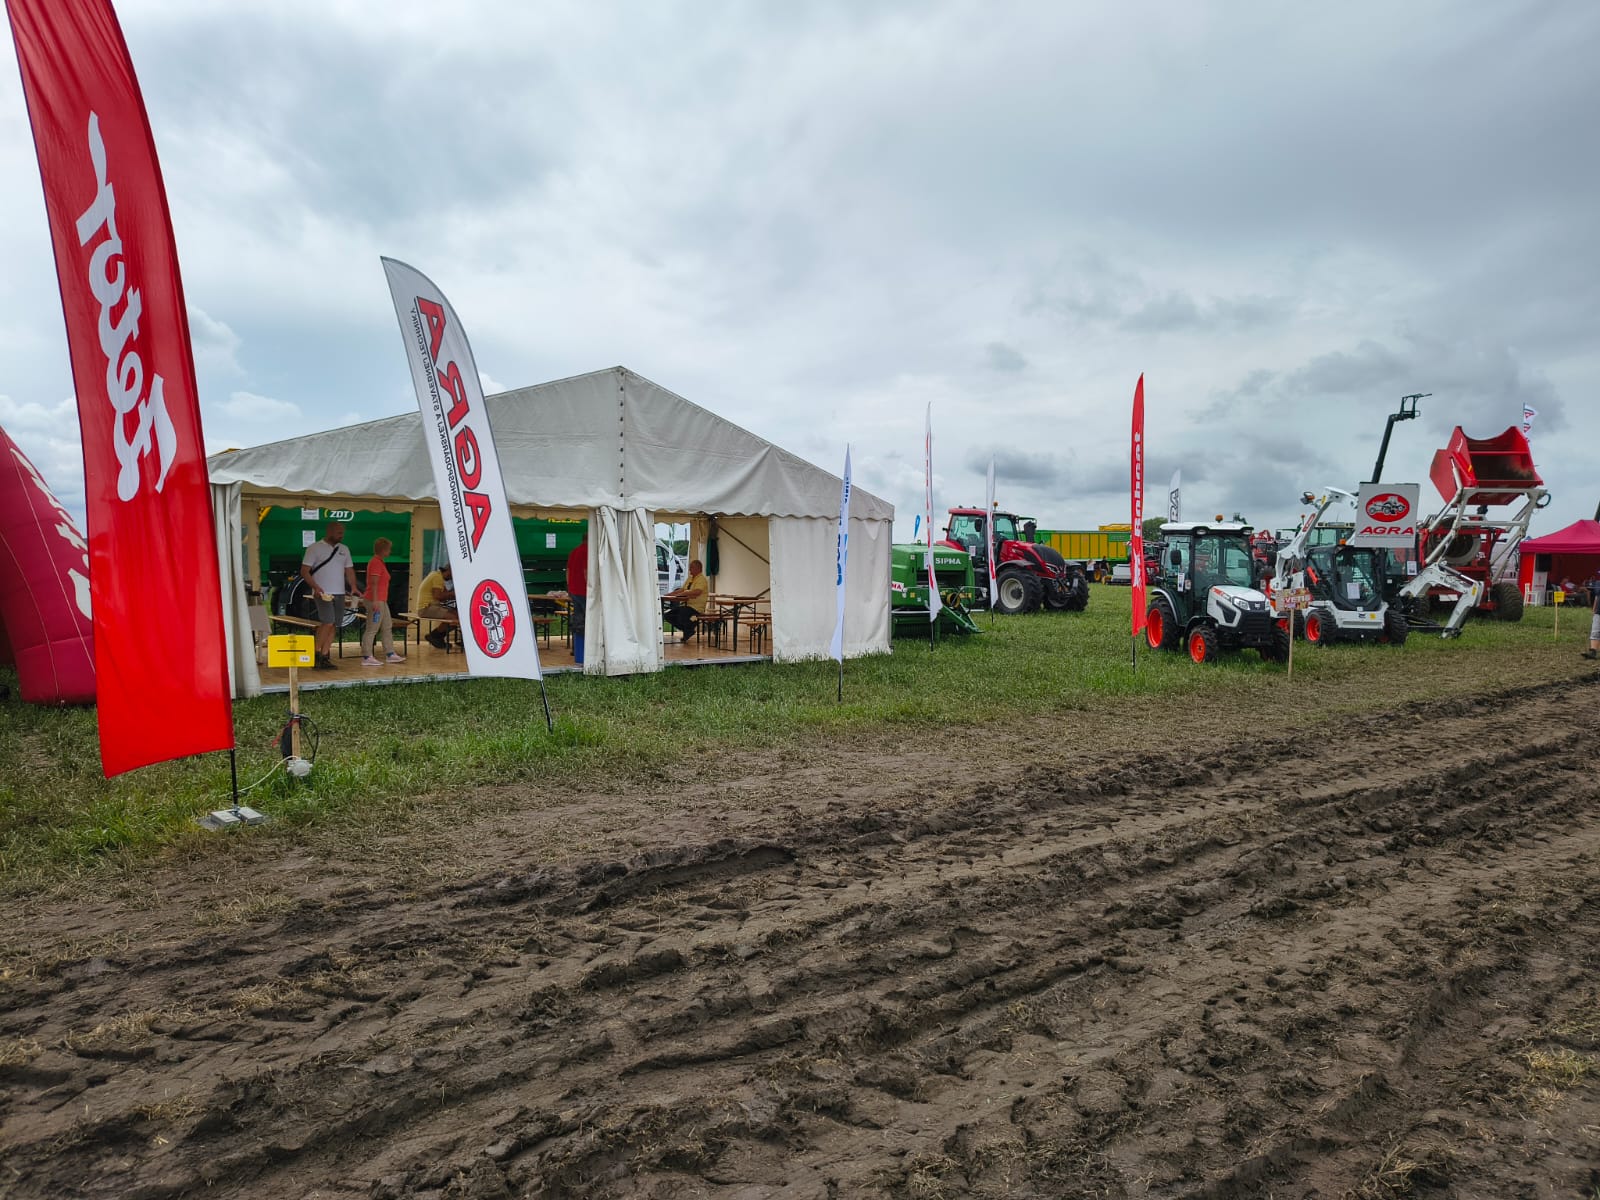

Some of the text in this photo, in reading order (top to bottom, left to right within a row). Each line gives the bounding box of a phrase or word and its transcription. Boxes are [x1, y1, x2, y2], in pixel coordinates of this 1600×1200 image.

[329, 510, 350, 518] ZDT
[1359, 525, 1415, 535] AGRA
[935, 557, 962, 565] SIPMA
